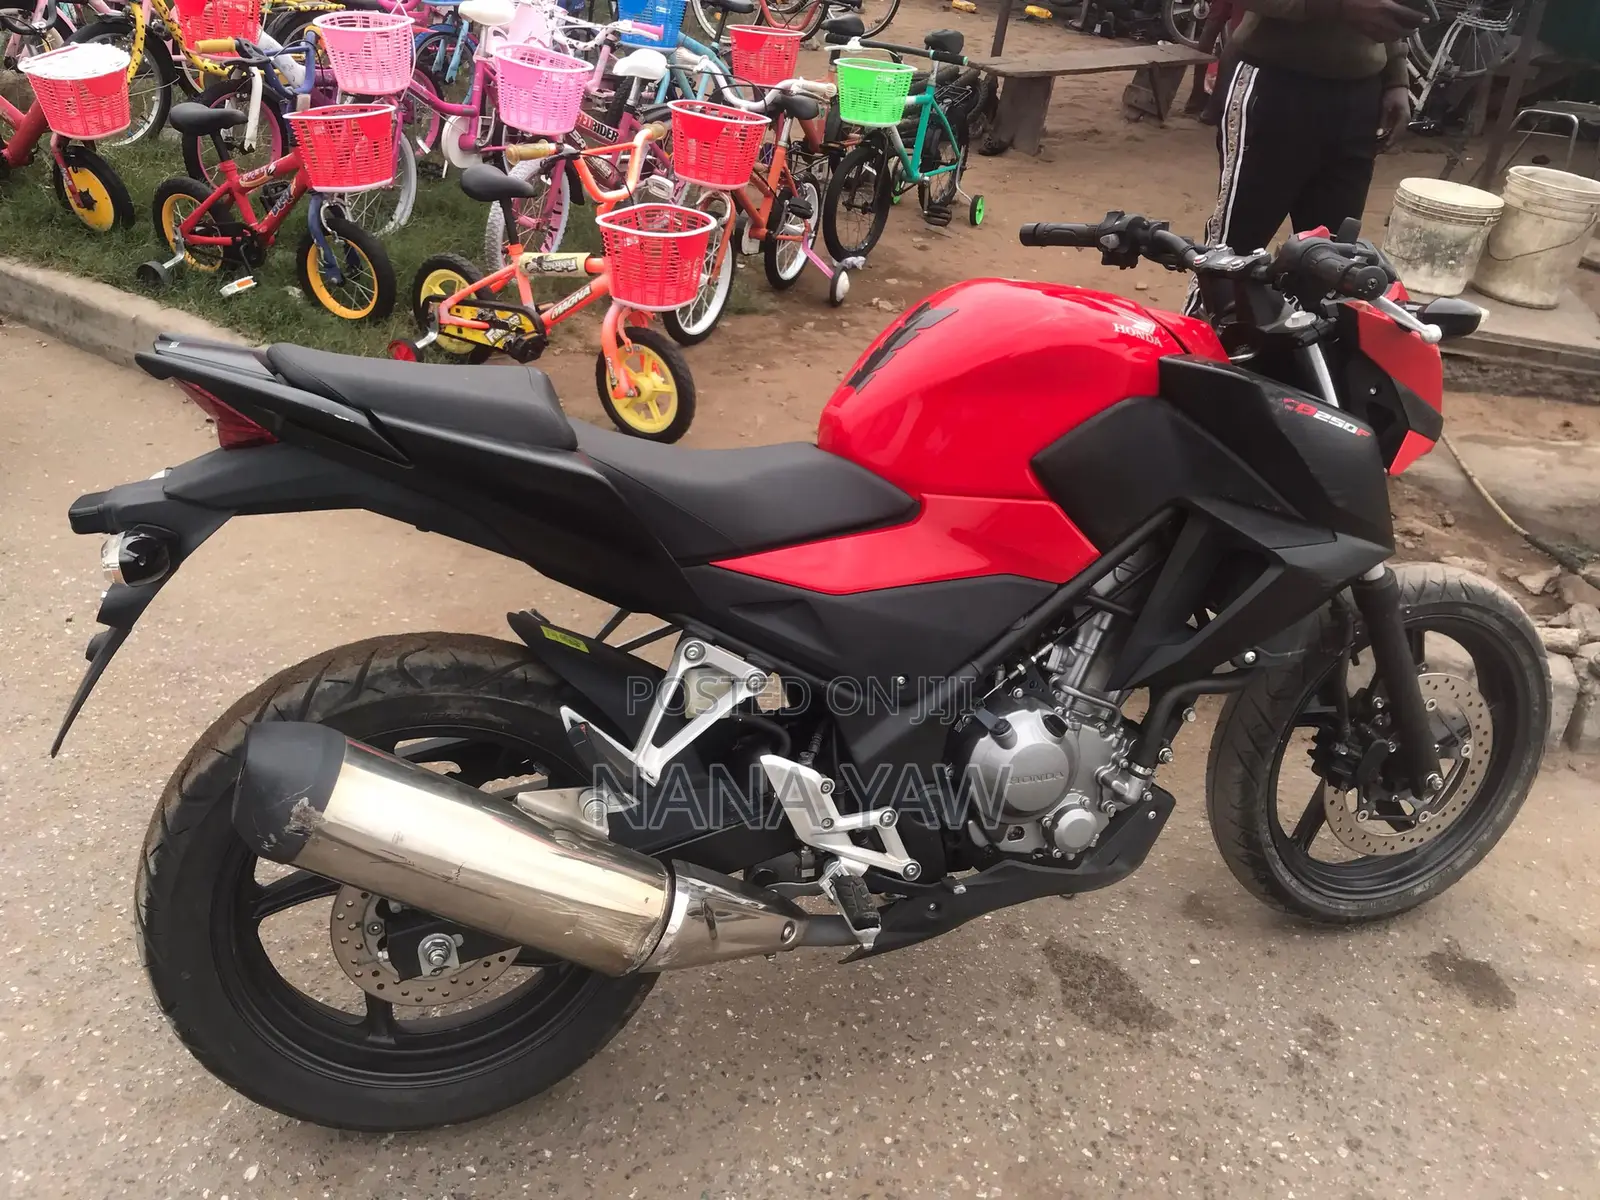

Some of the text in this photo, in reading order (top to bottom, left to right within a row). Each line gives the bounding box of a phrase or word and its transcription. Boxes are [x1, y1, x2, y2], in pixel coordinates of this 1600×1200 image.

[551, 284, 593, 320] MAGNA
[1112, 322, 1164, 348] HONDA
[1282, 397, 1372, 437] CB250F
[1006, 771, 1065, 786] HONDA
